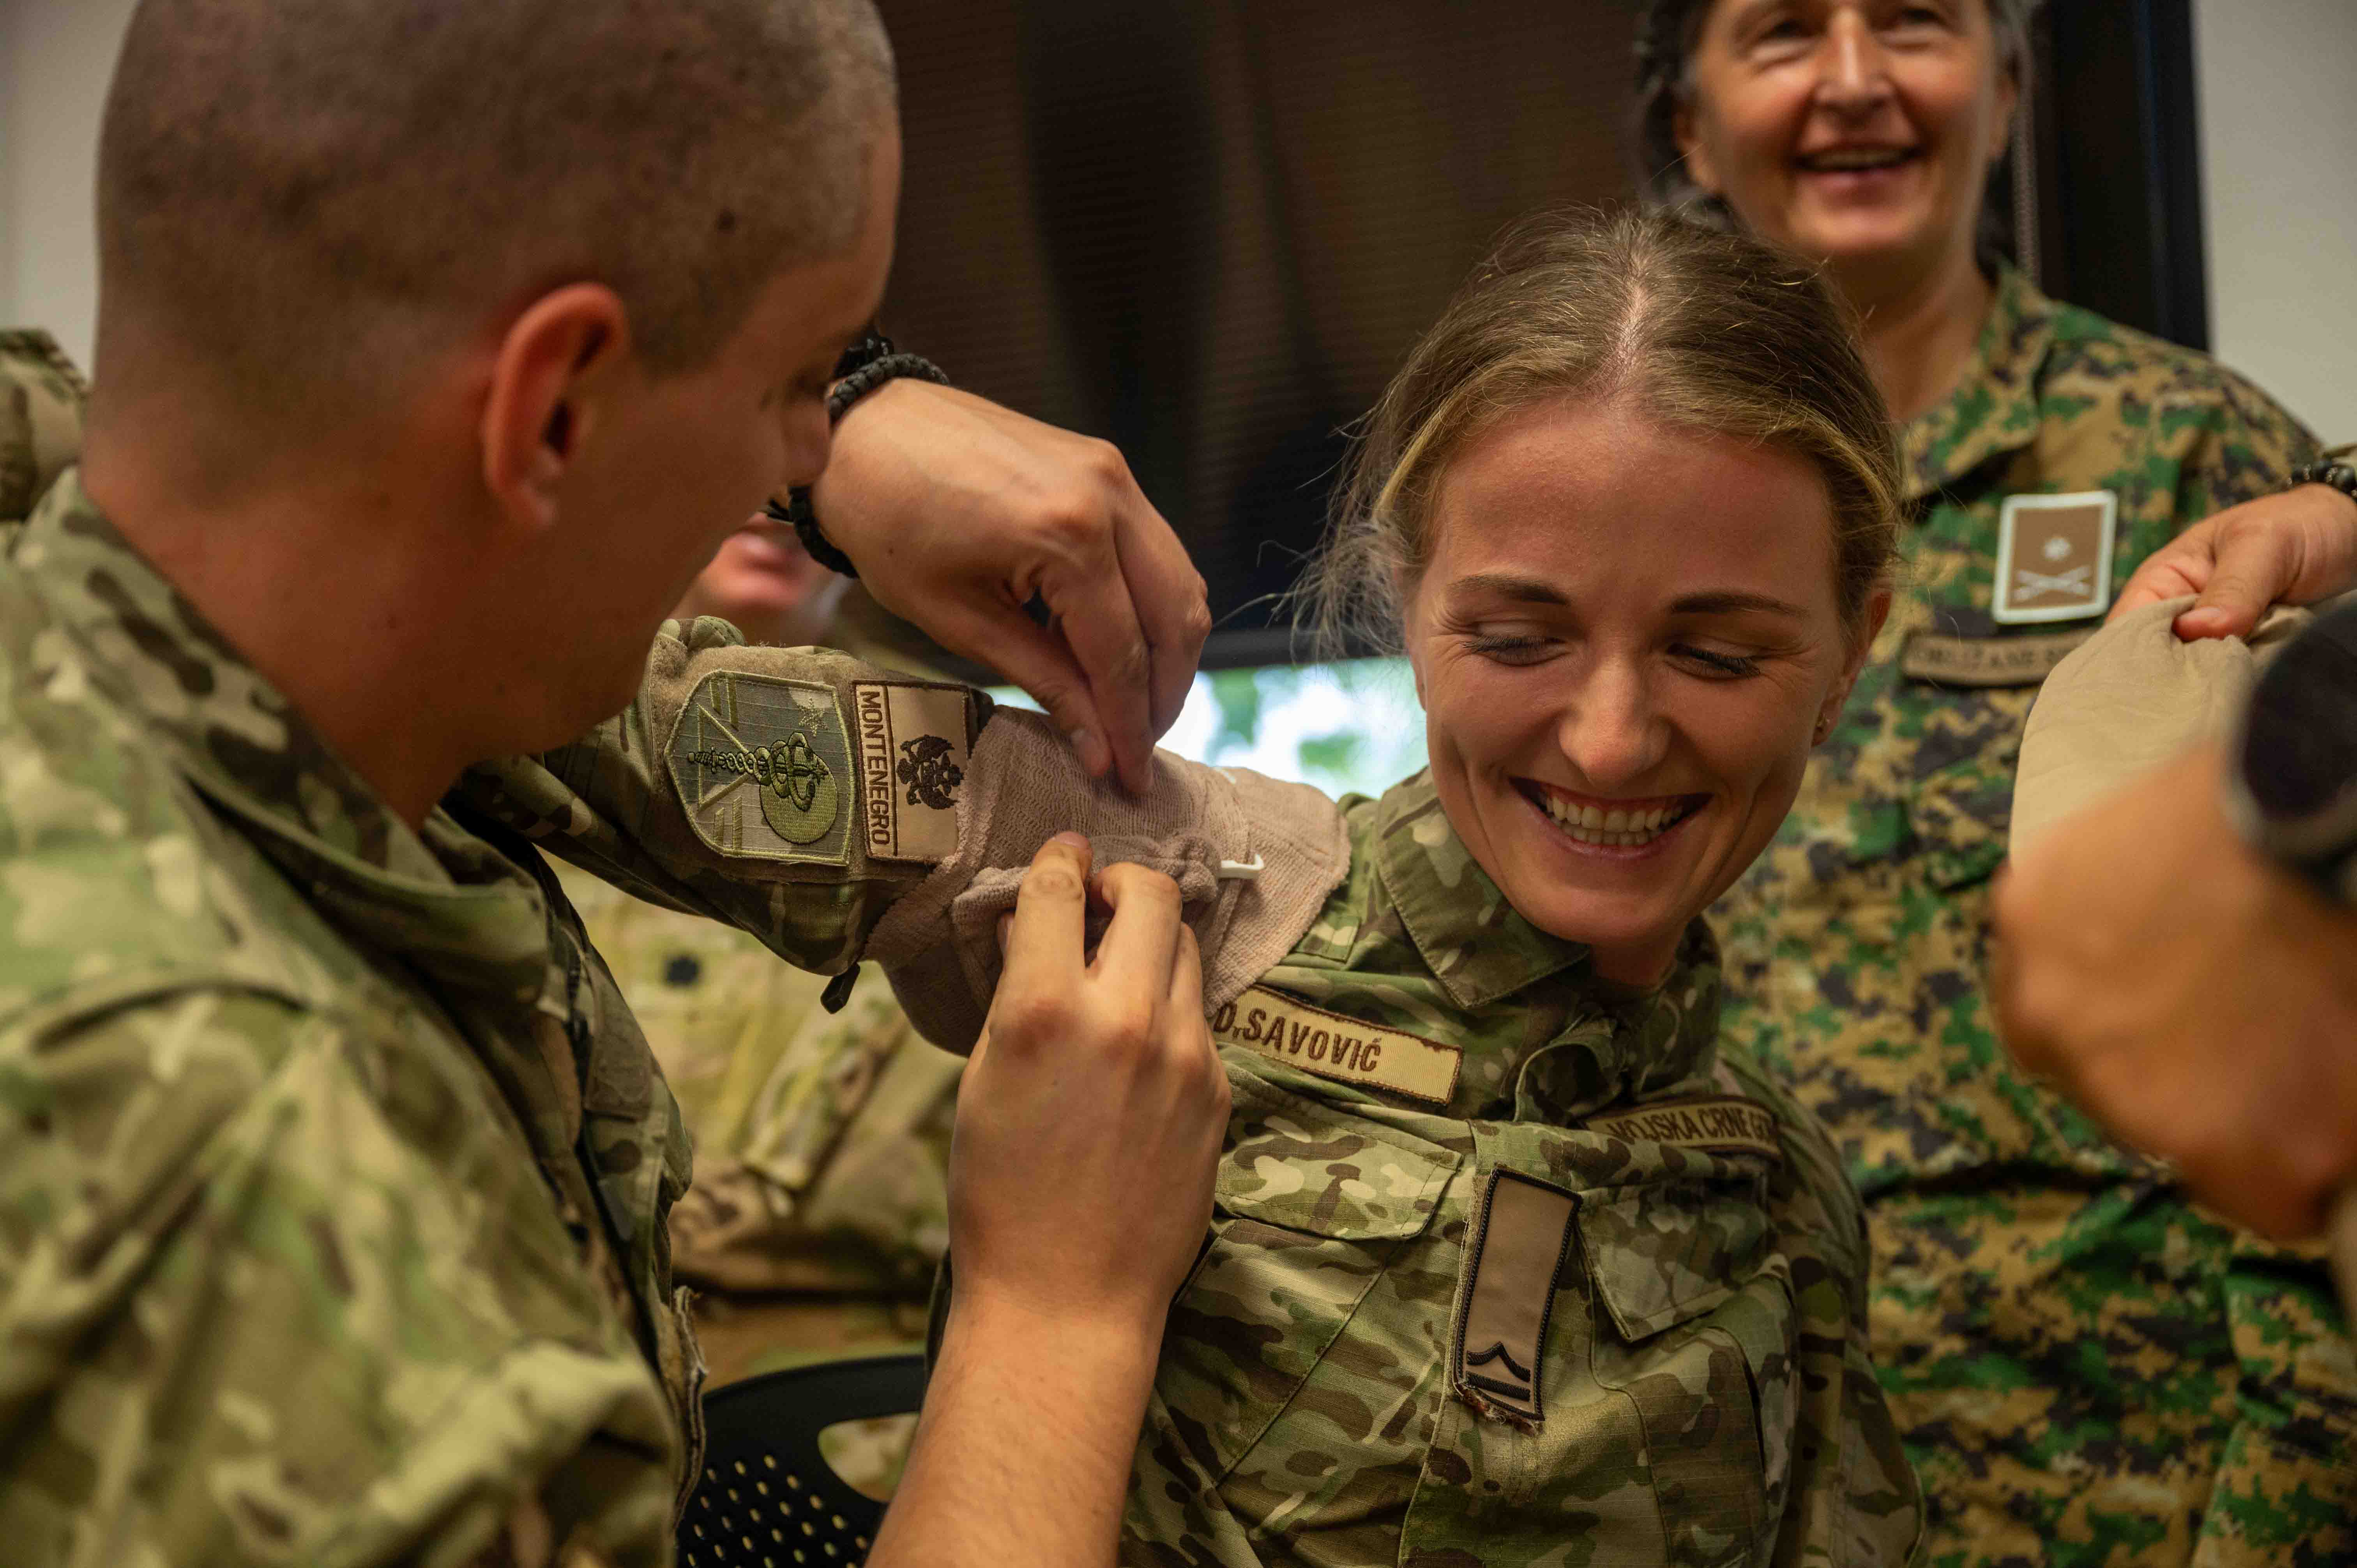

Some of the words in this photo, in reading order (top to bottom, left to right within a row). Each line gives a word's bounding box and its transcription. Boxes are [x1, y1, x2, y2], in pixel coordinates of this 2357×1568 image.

[859, 690, 890, 845] MONTENEGRO
[1606, 1111, 1703, 1142] VOJSKA
[1697, 1107, 1752, 1138] CRNE
